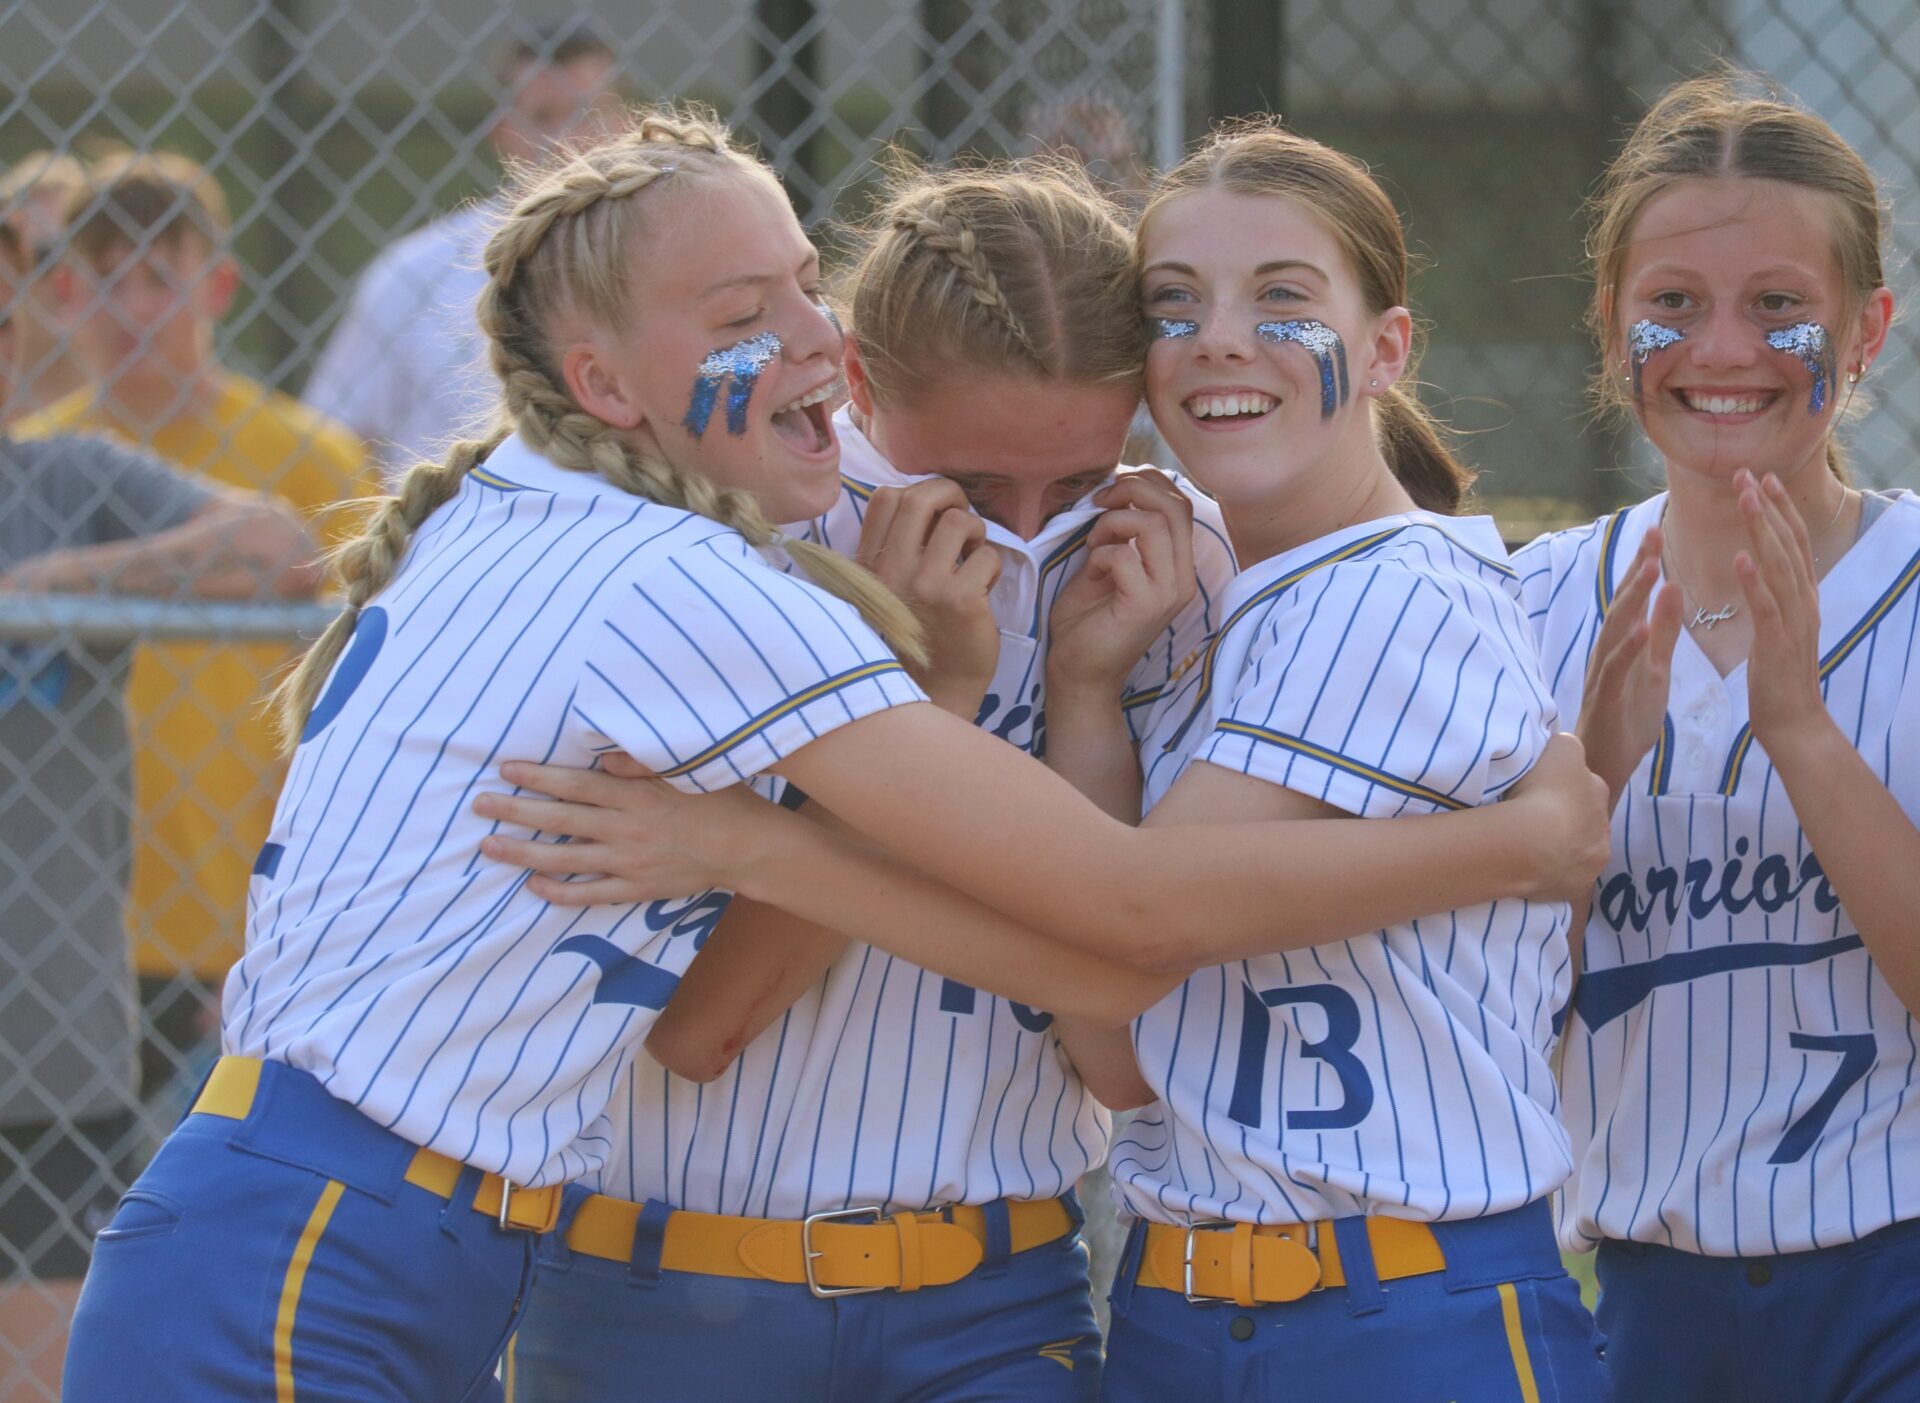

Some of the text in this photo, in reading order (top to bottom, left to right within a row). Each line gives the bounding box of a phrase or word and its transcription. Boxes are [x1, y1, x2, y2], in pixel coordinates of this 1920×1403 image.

[1601, 836, 1840, 932] arrior
[1228, 980, 1374, 1129] 13
[1767, 1031, 1877, 1164] 7
